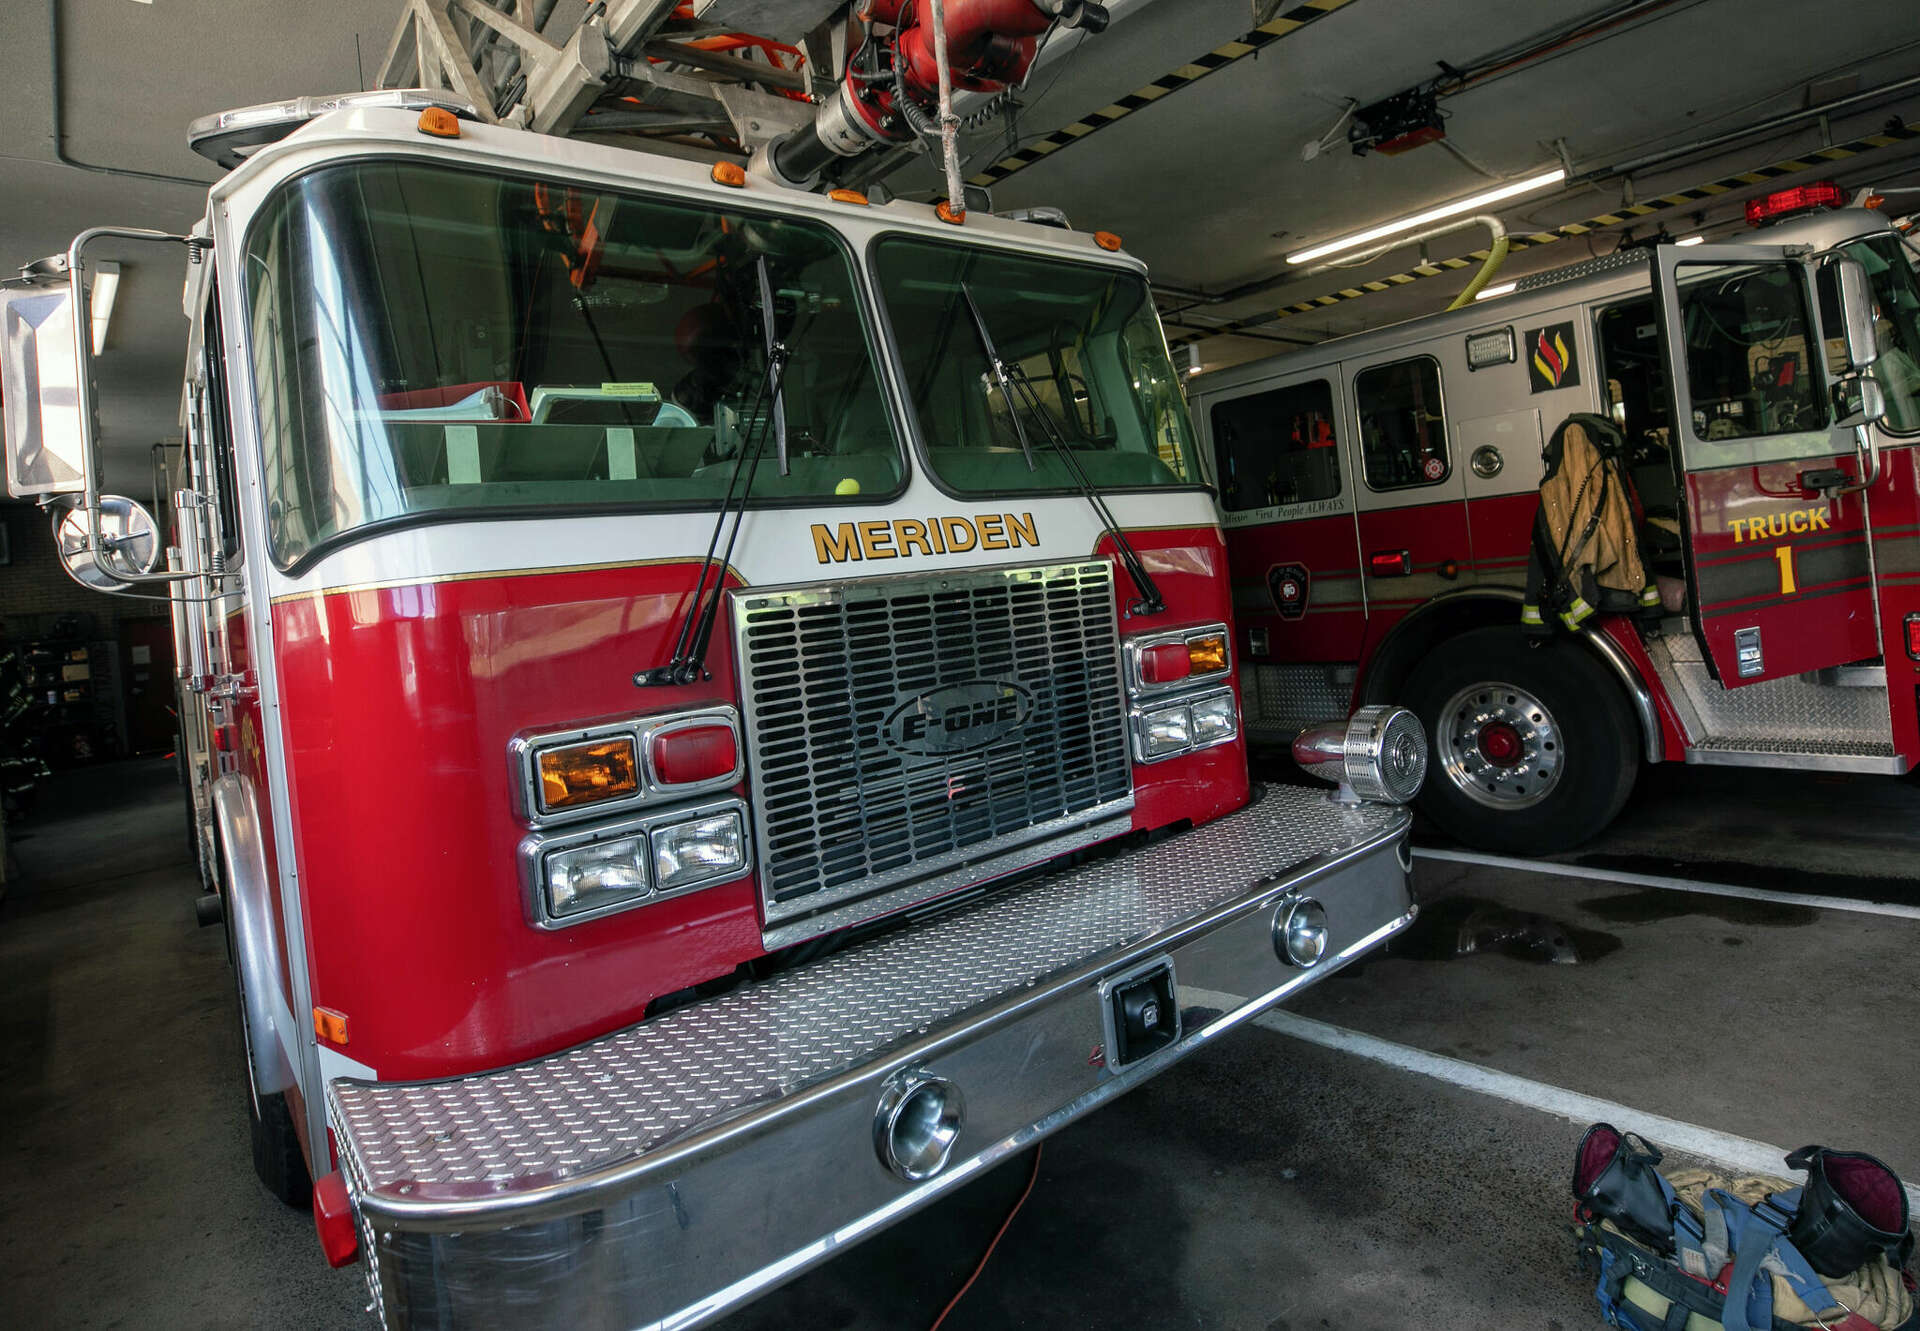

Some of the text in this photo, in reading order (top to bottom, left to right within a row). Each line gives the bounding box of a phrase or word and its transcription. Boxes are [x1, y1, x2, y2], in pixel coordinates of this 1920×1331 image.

[1278, 504, 1304, 519] People
[1304, 499, 1345, 513] ALWAYS
[1727, 506, 1830, 543] TRUCK
[811, 513, 1040, 564] MERIDEN
[1776, 546, 1796, 595] 1
[903, 694, 1018, 742] E-ONE
